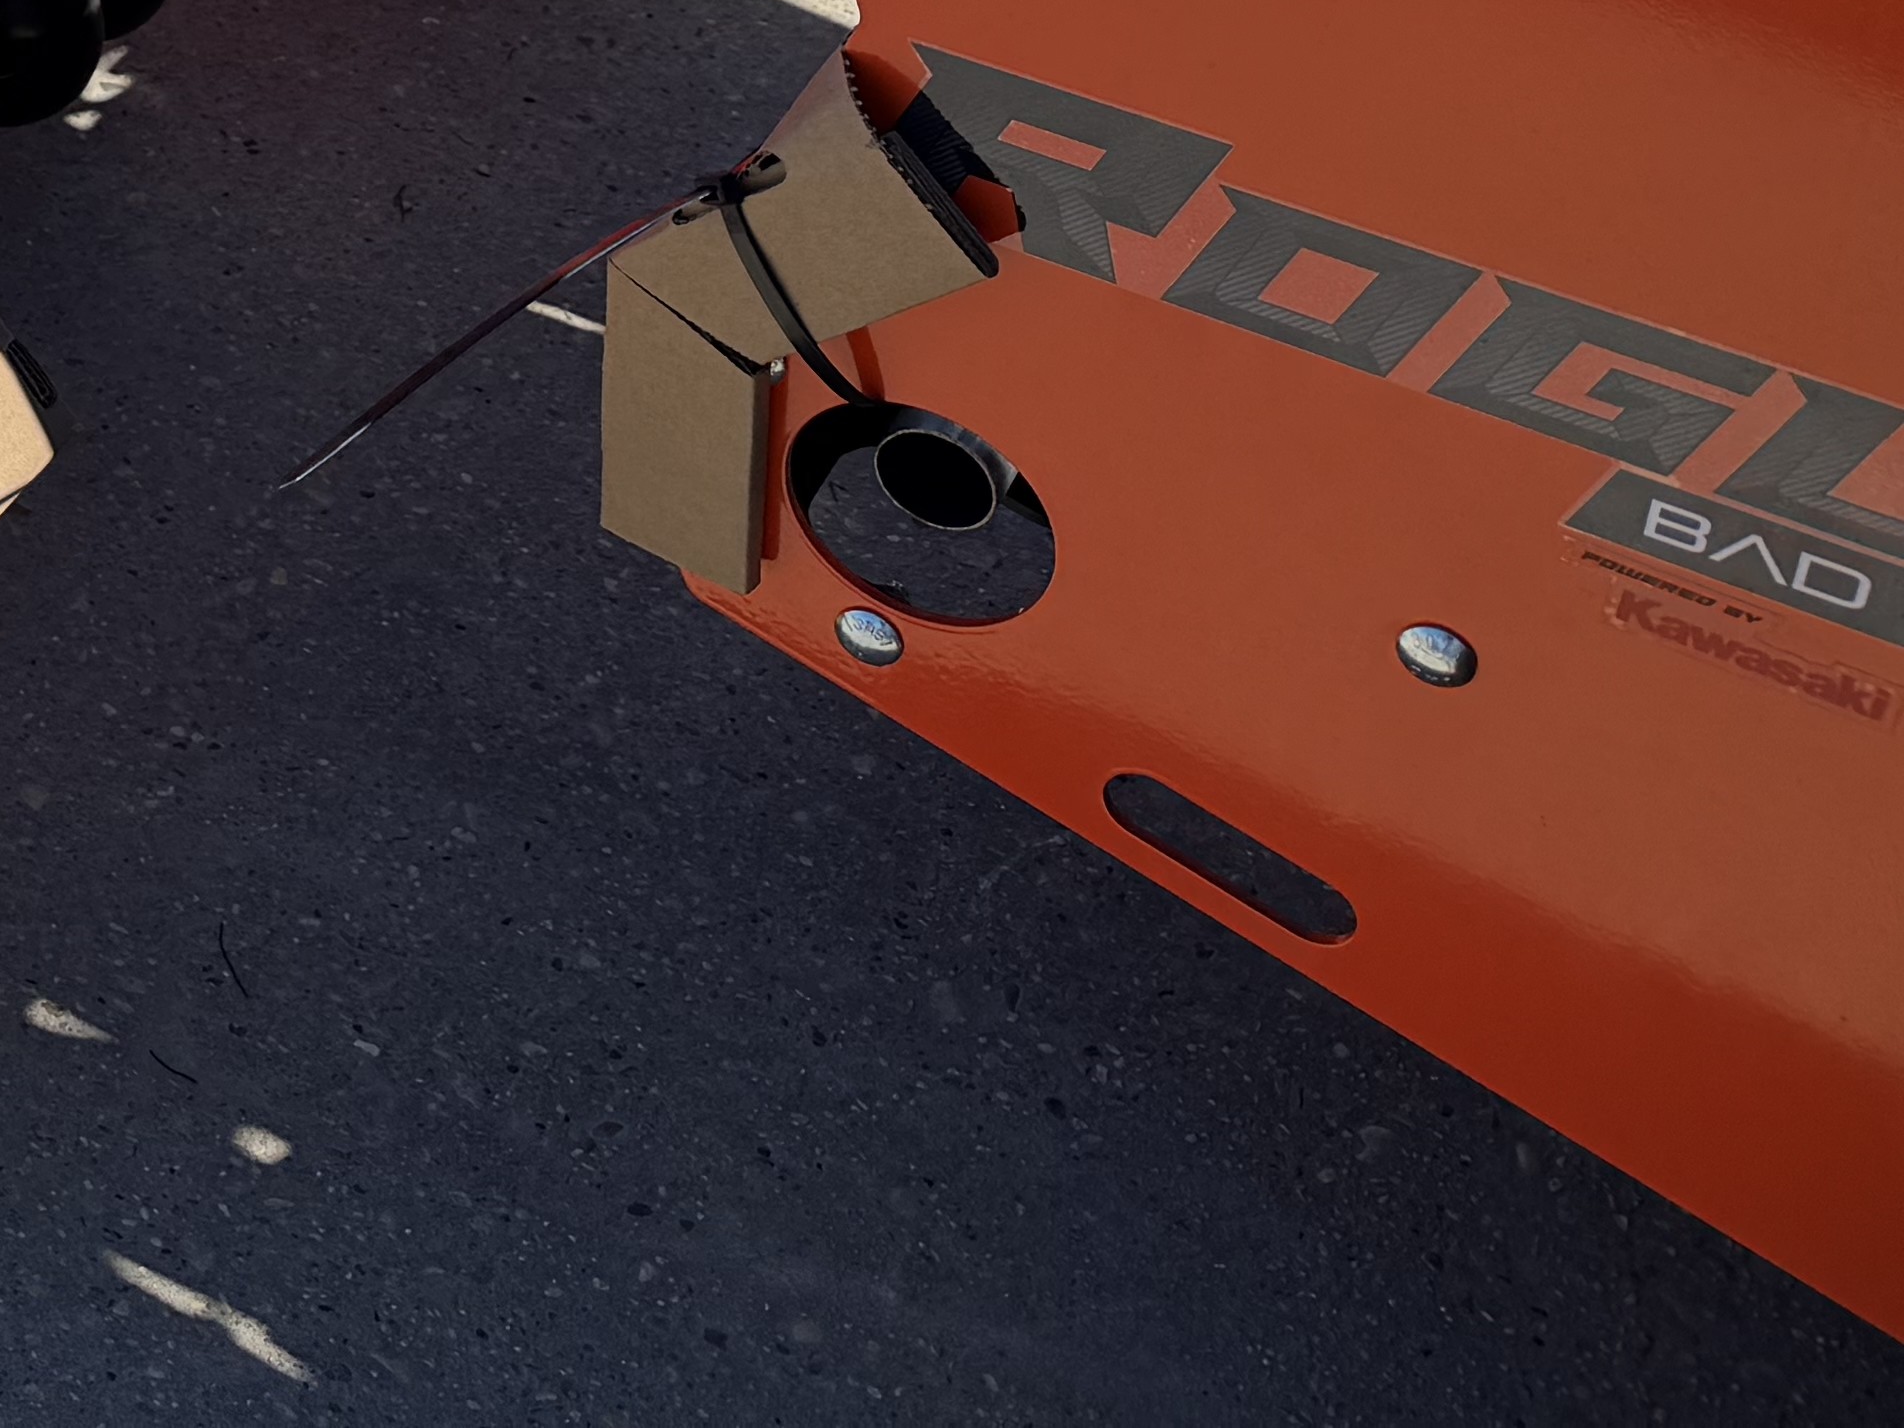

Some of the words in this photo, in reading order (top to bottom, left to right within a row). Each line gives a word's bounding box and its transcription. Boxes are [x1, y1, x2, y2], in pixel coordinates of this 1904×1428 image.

[1581, 550, 1717, 608] POWERED
[1723, 605, 1763, 624] BY
[1643, 498, 1872, 610] BAD
[1615, 590, 1892, 722] Kawasaki
